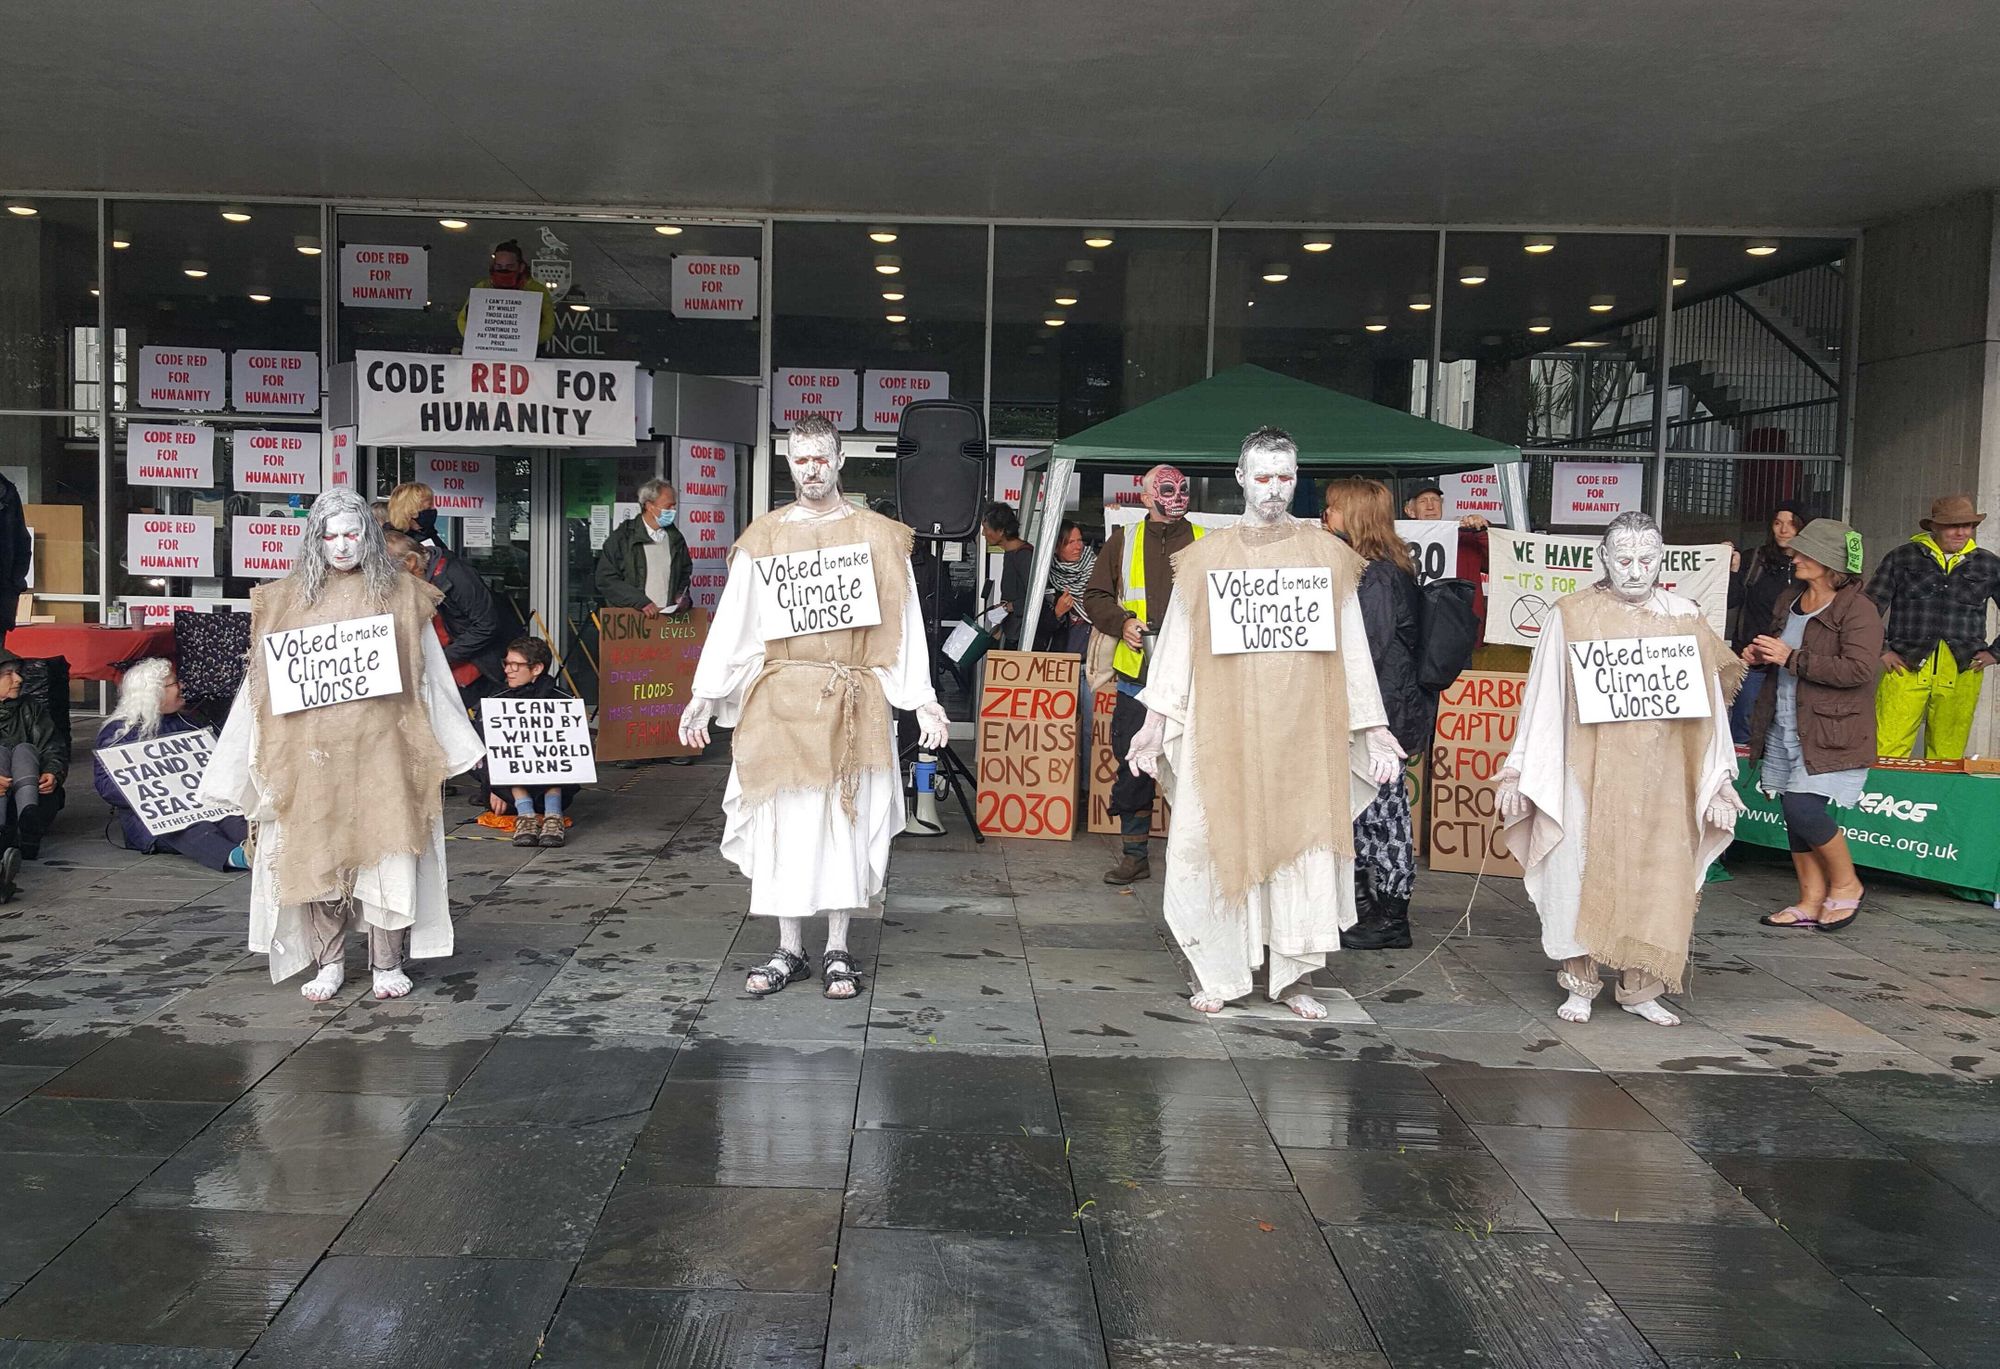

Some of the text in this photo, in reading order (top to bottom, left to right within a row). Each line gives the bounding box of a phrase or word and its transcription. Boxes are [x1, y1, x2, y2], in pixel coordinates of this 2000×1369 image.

[356, 252, 409, 265] CODE RED
[370, 270, 391, 281] FOR
[688, 262, 740, 276] CODE RED
[353, 286, 412, 300] HUMANITY
[702, 281, 722, 292] FOR
[684, 298, 744, 310] HUMANITY
[555, 312, 618, 332] WALL
[546, 336, 605, 354] NCIL
[155, 354, 207, 367] CODE RED
[249, 356, 302, 370] CODE RED
[169, 371, 190, 384] FOR
[262, 373, 284, 386] FOR
[367, 361, 616, 402] CODE RED FOR
[789, 375, 840, 387] CODE RED
[880, 377, 930, 389] CODE RED
[151, 388, 210, 402] HUMANITY
[246, 391, 305, 405] HUMANITY
[802, 393, 822, 404] FOR
[421, 402, 591, 436] HUMANITY
[144, 431, 195, 444] CODE RED
[250, 437, 302, 450] CODE RED
[157, 449, 178, 461] FOR
[691, 446, 725, 460] CODE RED
[264, 455, 284, 467] FOR
[431, 460, 480, 472] CODE RED
[991, 455, 1004, 467] CO
[140, 466, 198, 480] HUMANITY
[246, 472, 305, 485] HUMANITY
[701, 466, 716, 478] FOR
[1462, 474, 1498, 483] CODE RE
[444, 478, 464, 489] FOR
[1577, 476, 1618, 485] CODE RED
[687, 483, 728, 497] HUMANITY
[1471, 488, 1488, 496] FOR
[1587, 489, 1604, 498] FOR
[1457, 501, 1503, 510] HUMANITY
[1572, 502, 1620, 512] HUMANITY
[690, 511, 725, 523] CODE RED
[144, 522, 195, 534] CODE RED
[248, 523, 300, 536] CODE RED
[700, 530, 715, 541] FOR
[158, 539, 178, 551] FOR
[262, 541, 283, 552] FOR
[1407, 542, 1445, 579] 30
[1512, 540, 1535, 563] WE
[1546, 544, 1594, 568] HAVE
[140, 556, 199, 569] HUMANITY
[244, 558, 292, 570] HUMANI
[756, 551, 822, 586] Voted
[825, 559, 835, 569] to
[692, 576, 725, 587] CODE RED
[1211, 570, 1278, 600] Voted
[1282, 579, 1293, 589] to
[1519, 573, 1576, 593] IT'S FOR
[778, 574, 862, 607] Climate
[701, 594, 715, 605] FOR
[790, 602, 853, 632] Worse
[1230, 596, 1320, 624] Climate
[602, 613, 651, 642] RISING
[667, 613, 690, 624] SEA
[660, 627, 696, 639] LEVELS
[266, 624, 337, 661] Voted
[341, 630, 353, 642] to
[1242, 624, 1309, 648] Worse
[1572, 640, 1642, 668] Voted
[1647, 647, 1658, 657] to
[288, 647, 379, 684] Climate
[988, 658, 1079, 683] TO MEET
[1596, 666, 1689, 694] Climate
[301, 676, 369, 708] Worse
[634, 683, 674, 700] FLOODS
[502, 701, 573, 714] I CAN'T
[640, 704, 686, 716] MIGRATIO
[981, 688, 1076, 720] ZERO
[1609, 693, 1680, 717] Worse
[490, 716, 583, 728] STAND BY
[1436, 712, 1518, 742] CAPTU
[502, 731, 565, 743] WHILE
[626, 720, 681, 748] FAMIN
[120, 734, 207, 764] I CAN'T
[489, 744, 590, 758] THE WORLD
[510, 760, 573, 774] BURNS
[1095, 748, 1118, 783] &
[1432, 746, 1454, 780] &
[113, 756, 188, 785] STAND
[981, 755, 1074, 787] IONS BY
[138, 780, 170, 801] AS
[140, 792, 203, 819] SEAS
[978, 790, 1071, 835] 2030
[1432, 821, 1510, 860] CTIO
[1737, 809, 1958, 861] www.peace.org.uk
